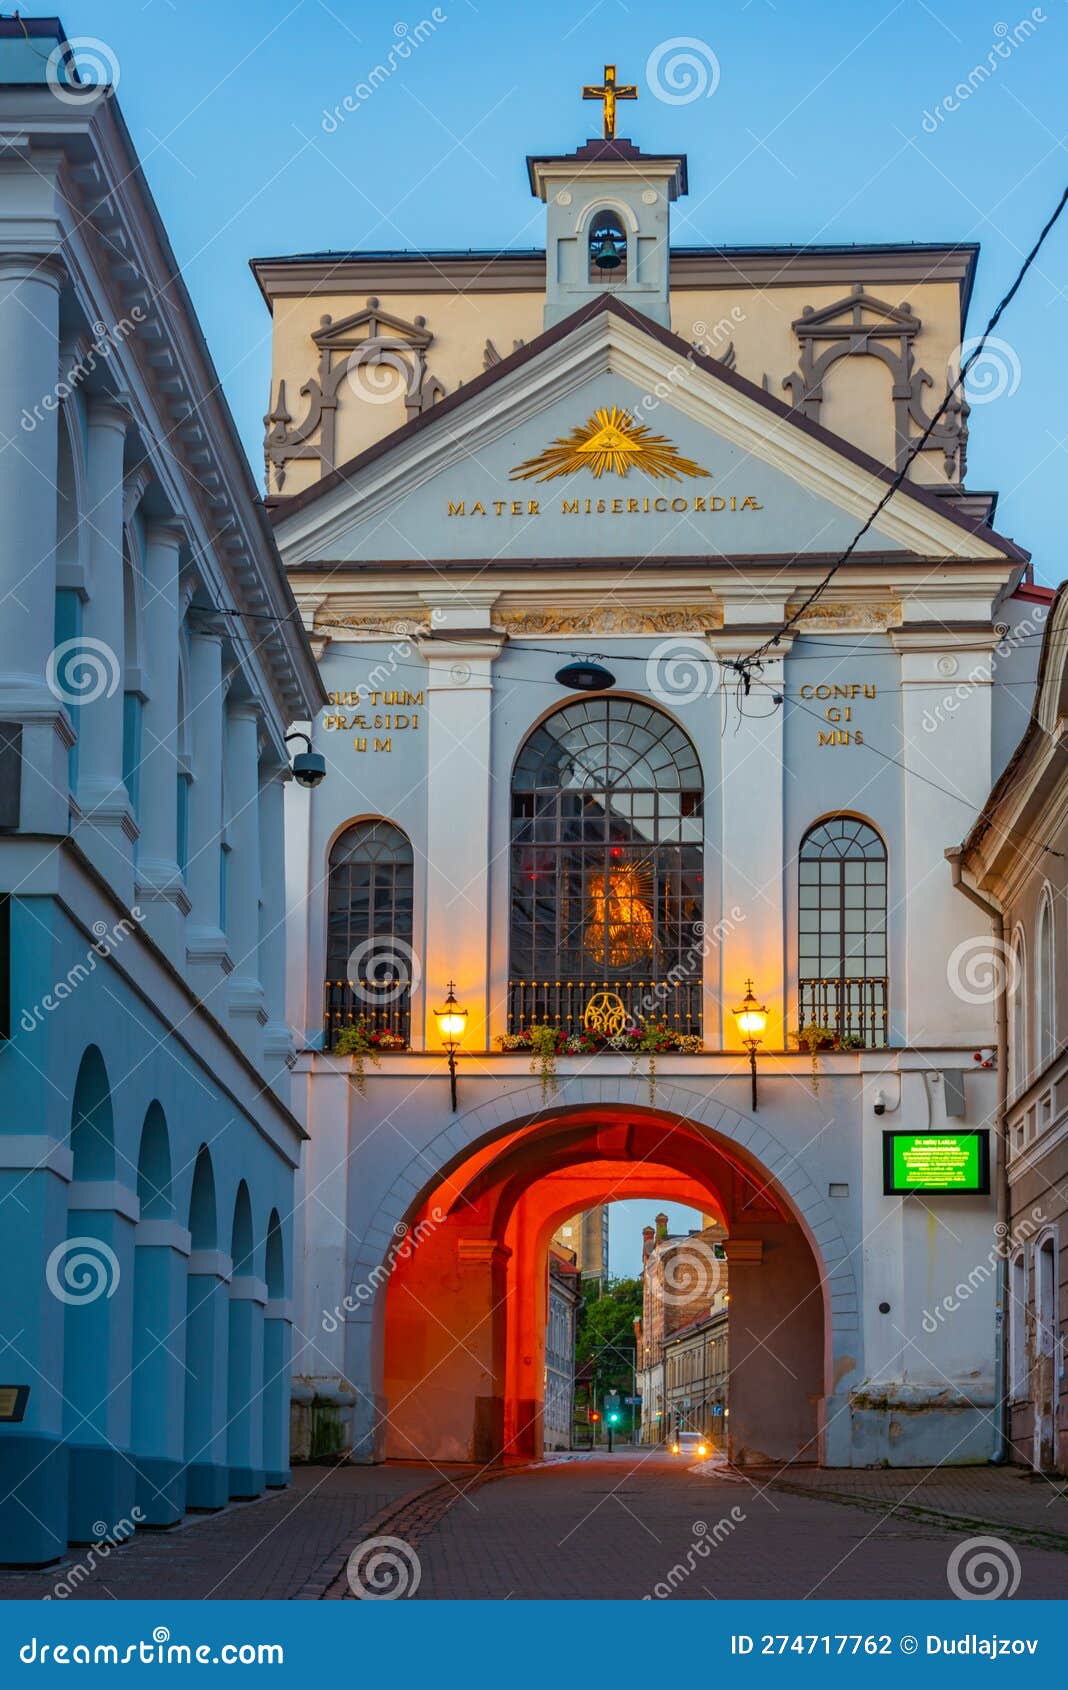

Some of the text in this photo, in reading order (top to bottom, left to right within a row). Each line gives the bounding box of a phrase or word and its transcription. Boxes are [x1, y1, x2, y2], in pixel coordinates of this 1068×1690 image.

[448, 501, 541, 516] MATER
[327, 691, 424, 706] SUB TUUM
[800, 684, 876, 700] CONFU
[825, 706, 852, 722] GI
[818, 730, 864, 746] MUS
